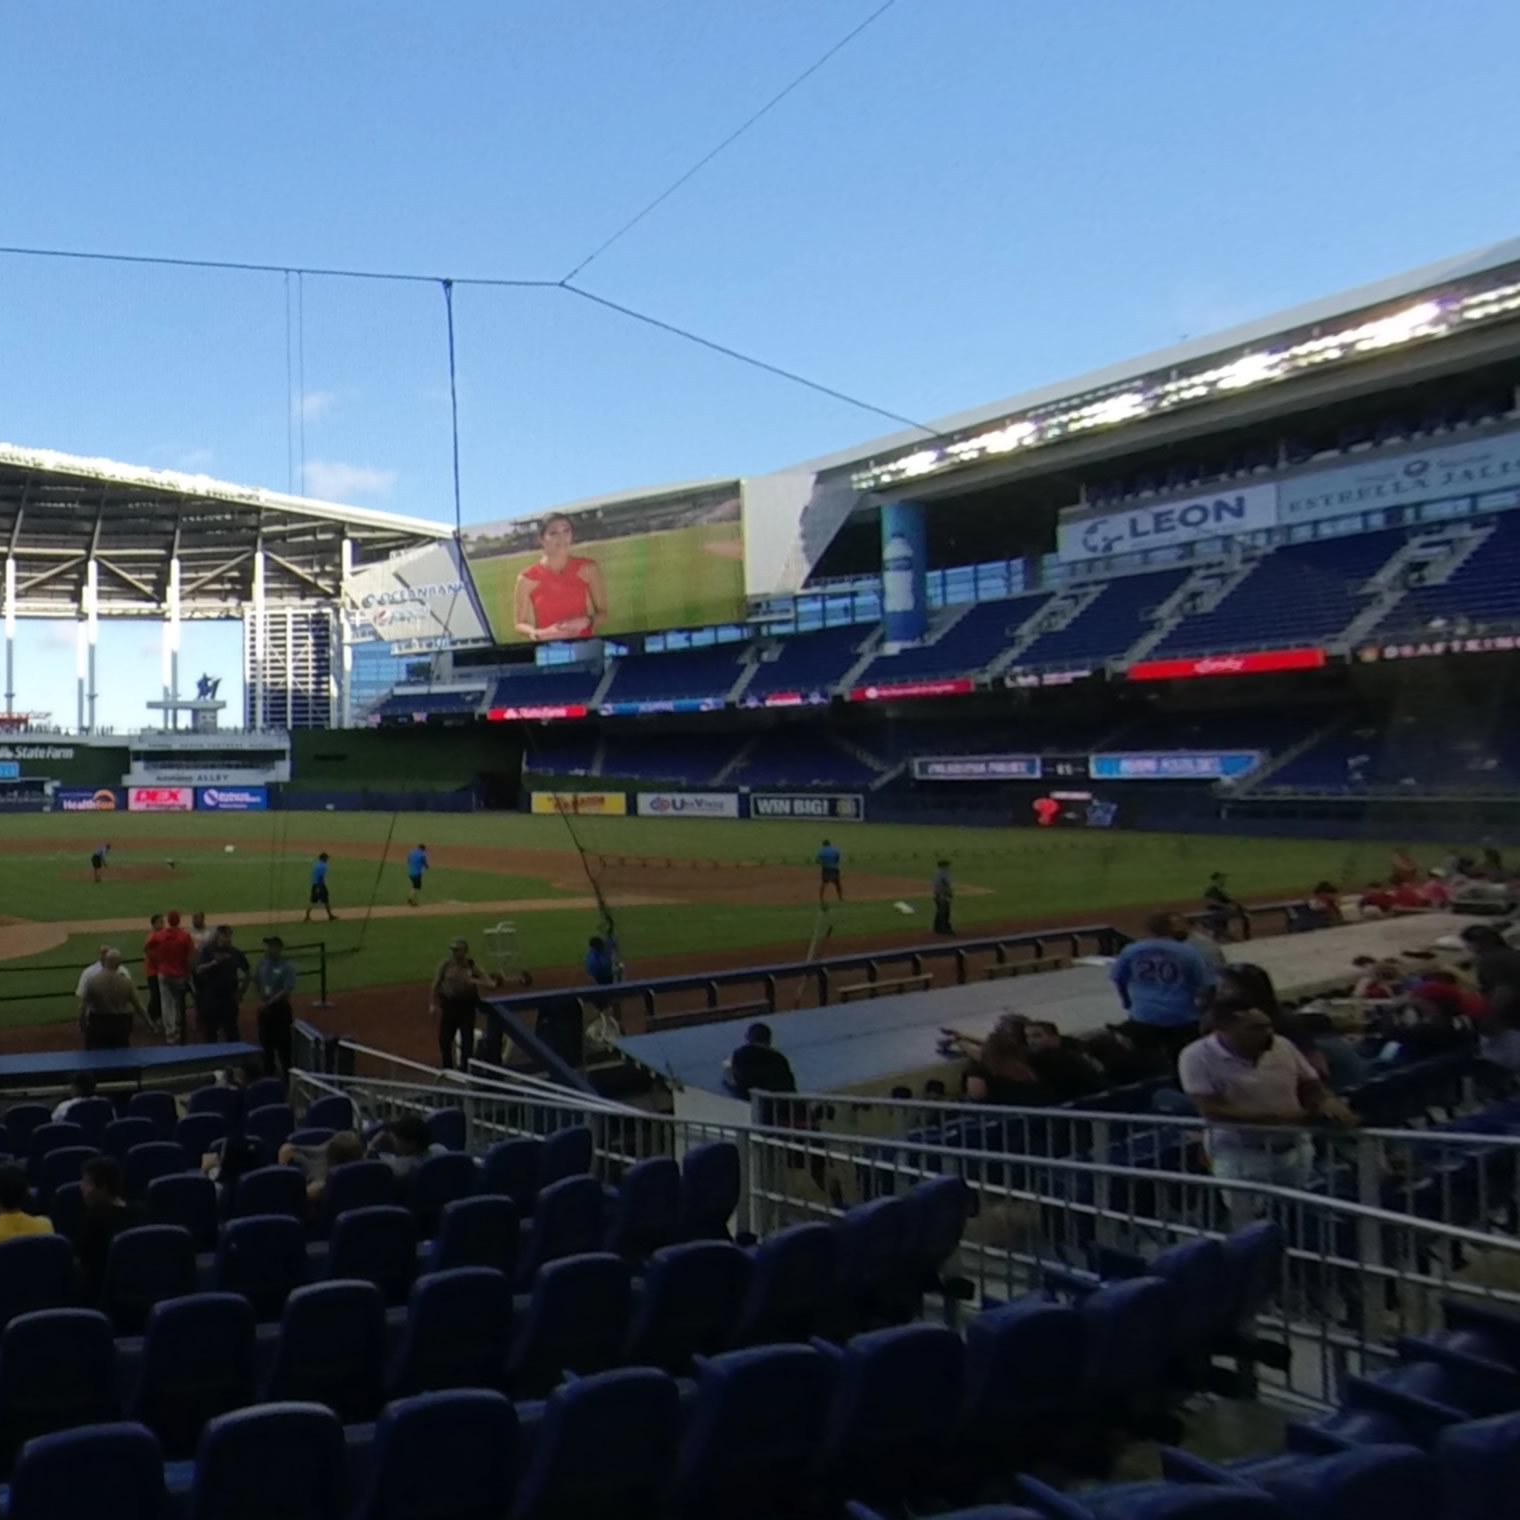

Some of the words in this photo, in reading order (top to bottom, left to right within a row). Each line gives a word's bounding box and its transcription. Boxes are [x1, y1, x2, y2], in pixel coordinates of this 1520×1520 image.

[1130, 496, 1245, 538] LEON
[197, 774, 229, 782] ALLEY
[757, 799, 791, 814] WIN
[793, 799, 829, 815] BIG!
[1136, 960, 1179, 984] 20
